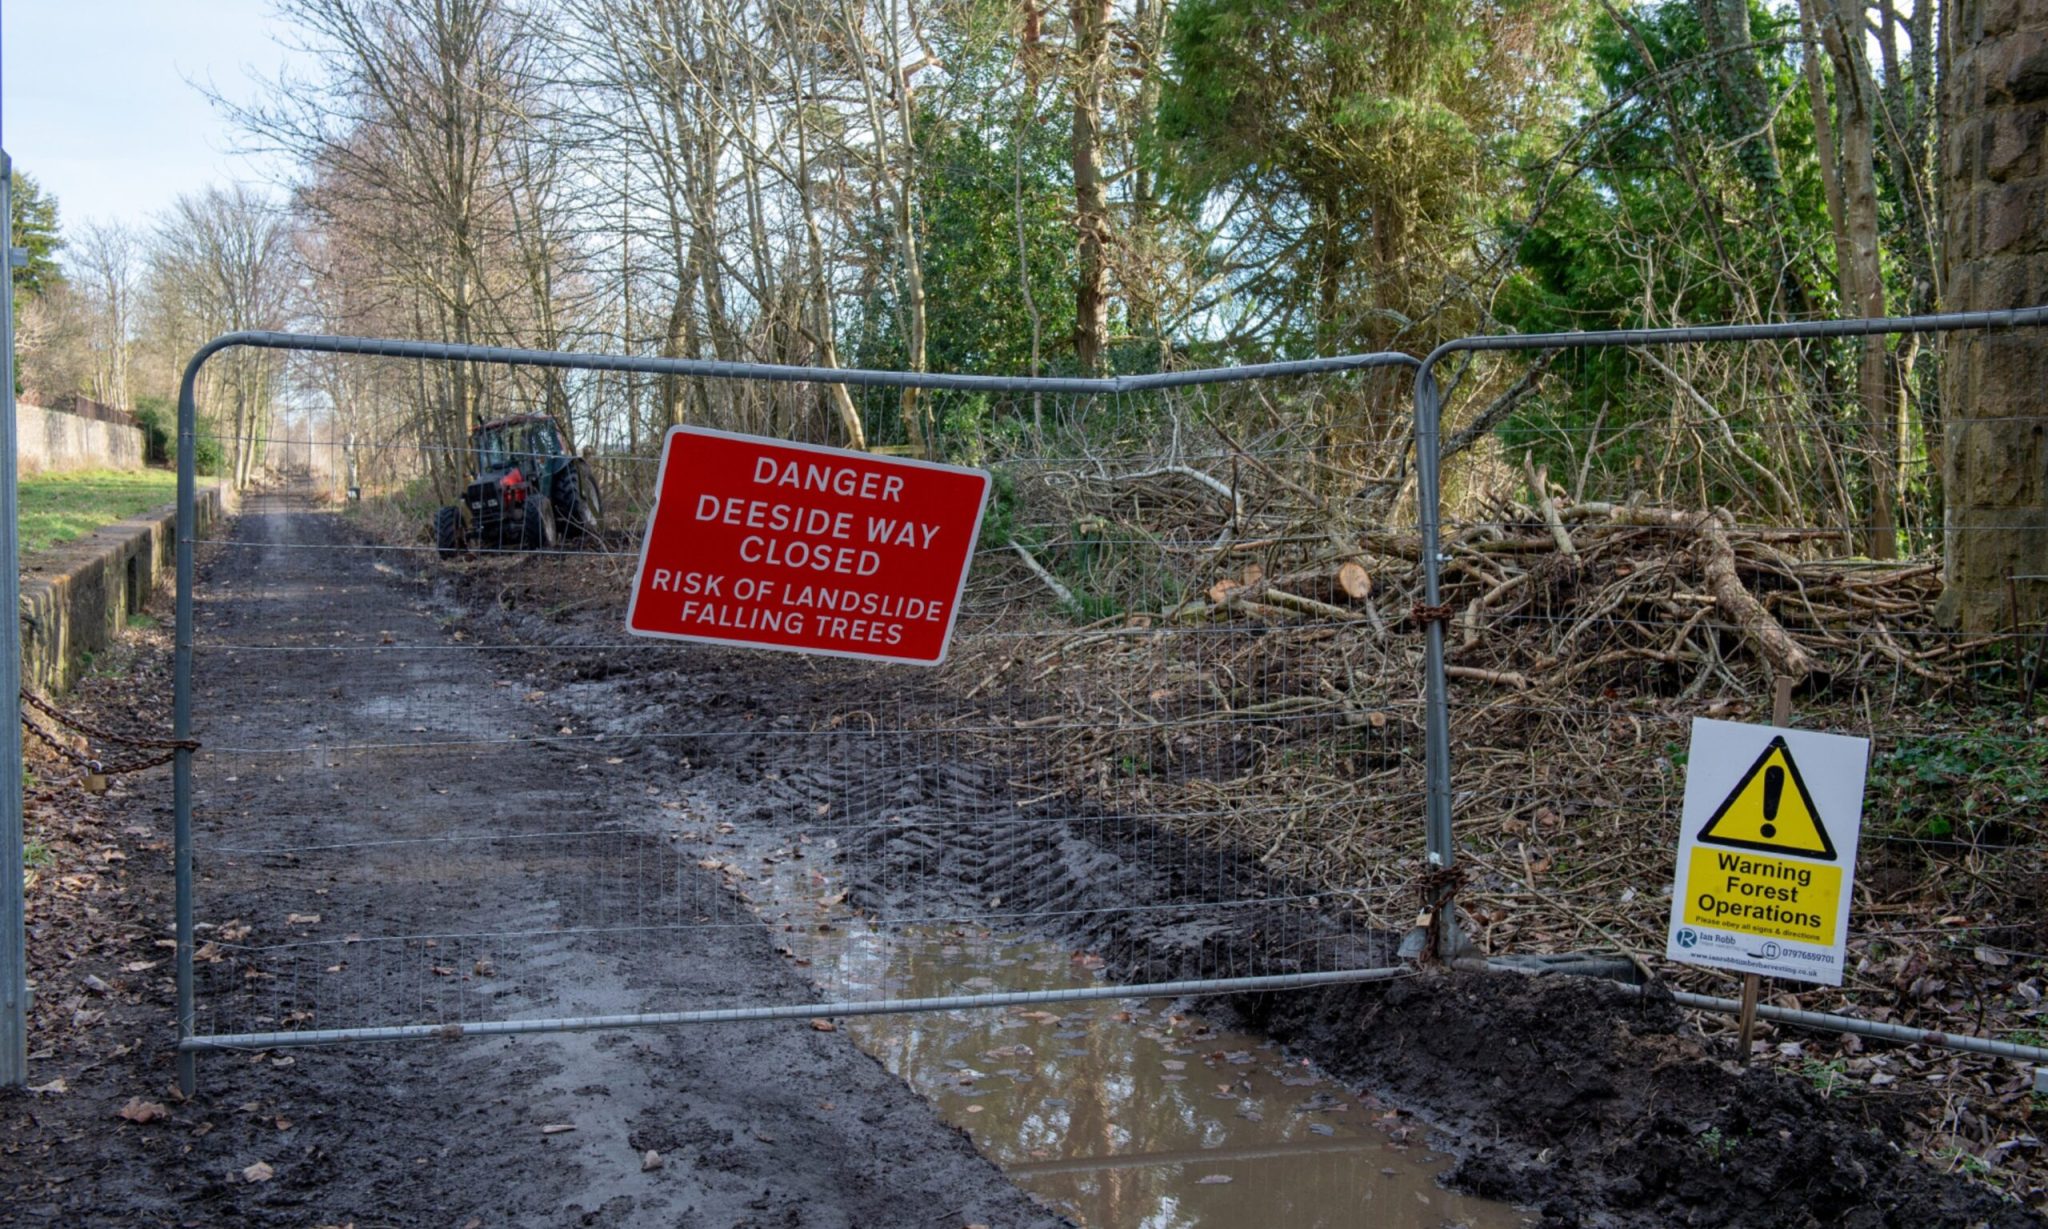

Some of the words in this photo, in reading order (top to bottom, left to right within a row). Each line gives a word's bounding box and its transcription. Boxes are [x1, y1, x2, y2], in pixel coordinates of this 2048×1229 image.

[754, 457, 904, 502] DANGER
[696, 495, 854, 539] DEESIDE
[868, 517, 941, 549] WAY
[740, 536, 880, 576] CLOSED
[651, 569, 725, 597] RISK
[734, 578, 775, 602] OF
[783, 584, 943, 622] LANDSLIDE
[681, 601, 804, 634] FALLING
[817, 616, 903, 645] TREES
[1718, 853, 1812, 886] Warning
[1727, 877, 1798, 903] Forest
[1696, 916, 1720, 926] Please
[1721, 921, 1740, 930] obey
[1741, 922, 1751, 930] all
[1752, 925, 1773, 934] signs
[1782, 929, 1821, 941] directions
[1698, 894, 1821, 928] Operations
[1699, 932, 1713, 941] Ian
[1715, 934, 1737, 945] Robb
